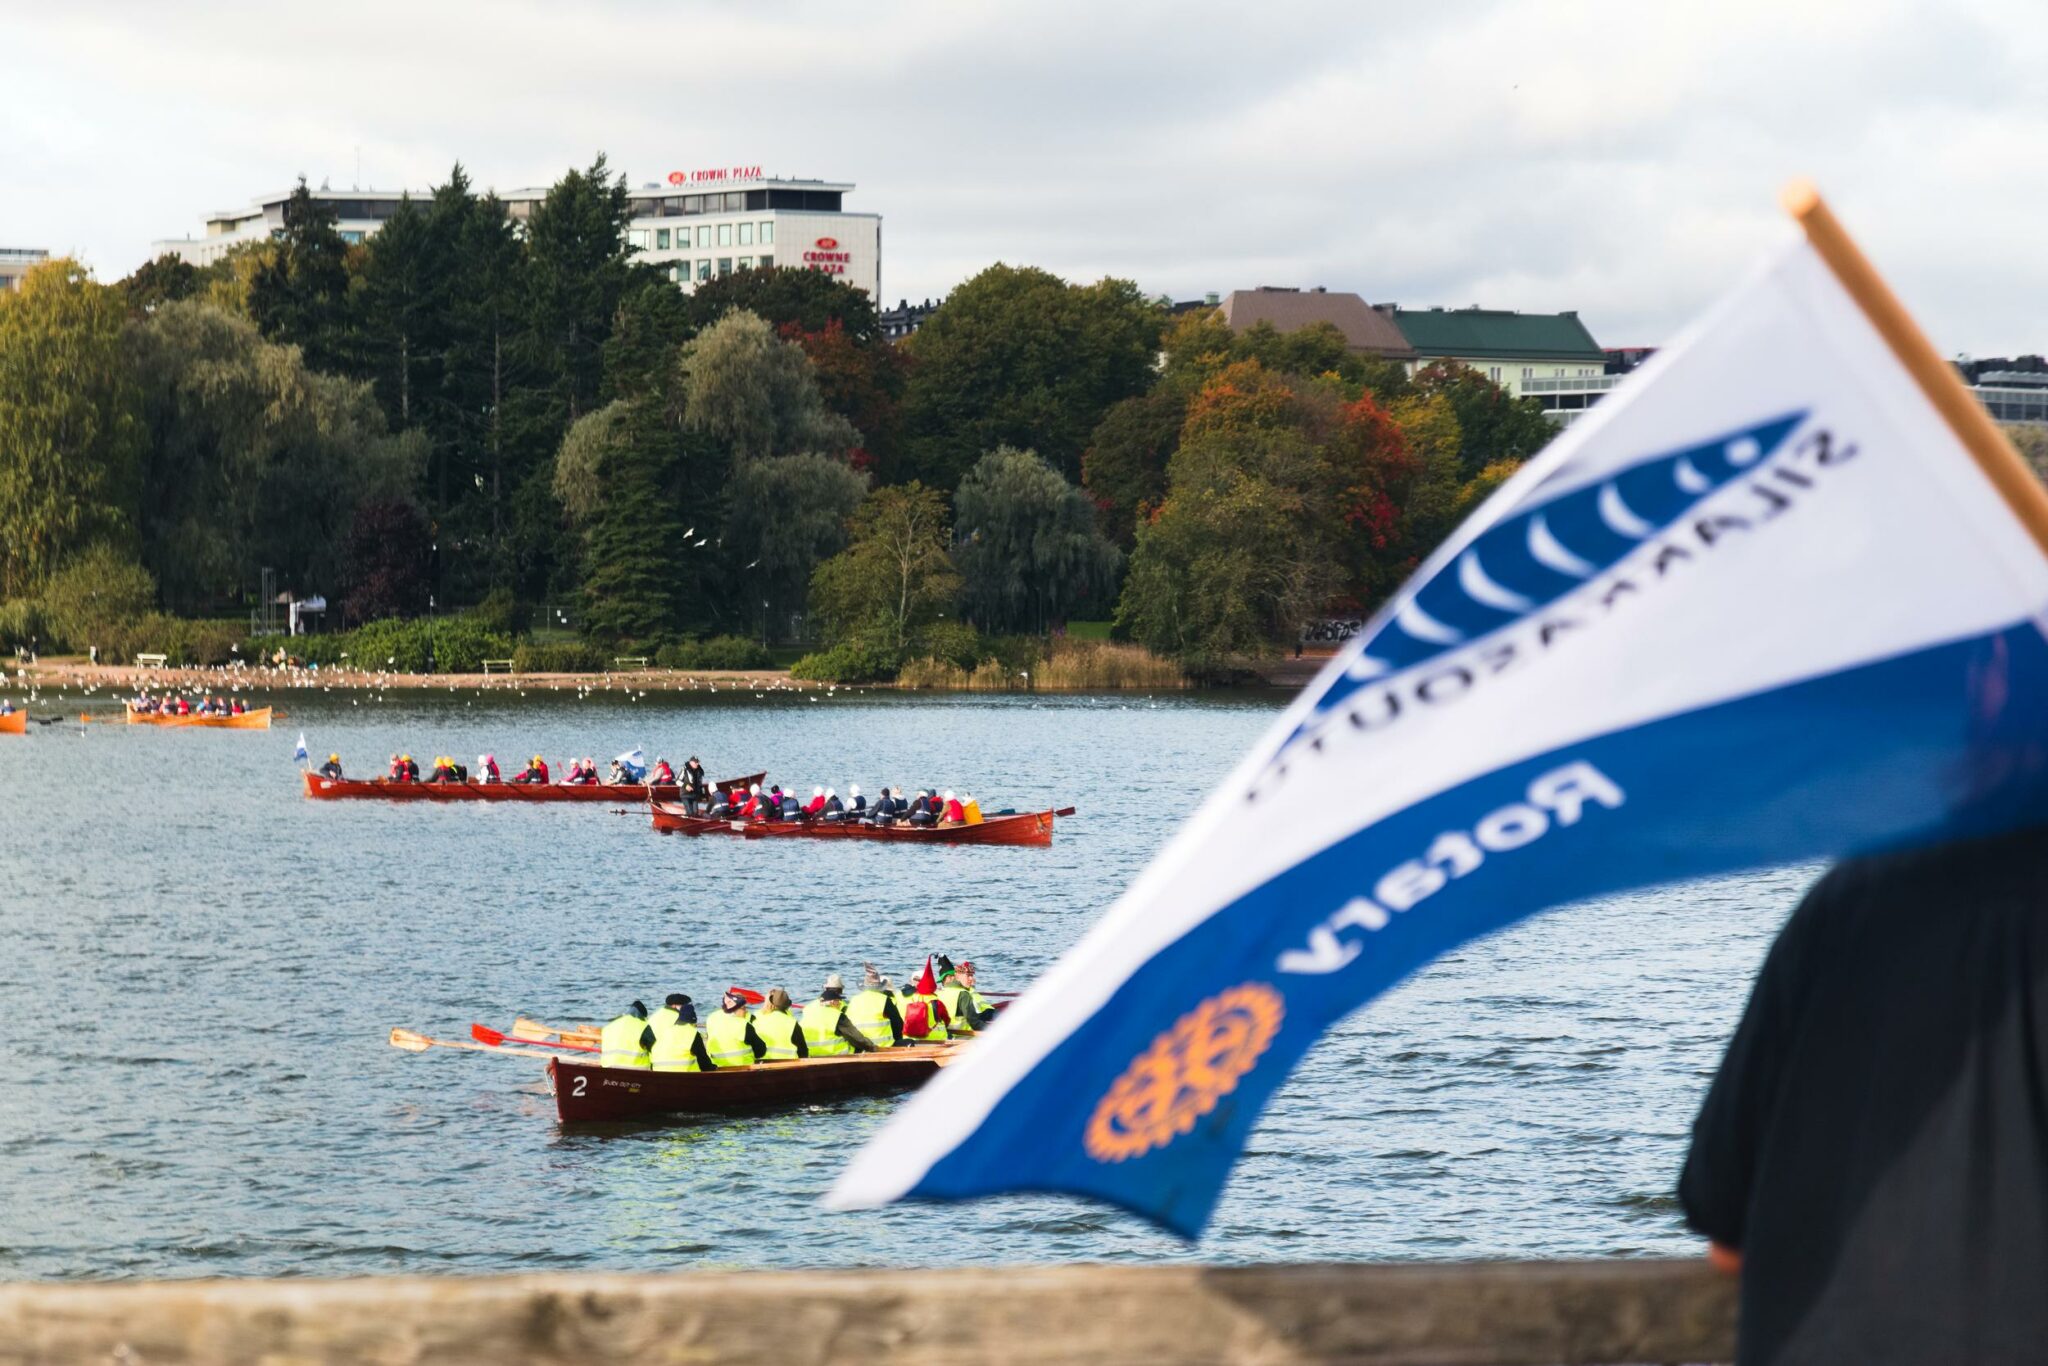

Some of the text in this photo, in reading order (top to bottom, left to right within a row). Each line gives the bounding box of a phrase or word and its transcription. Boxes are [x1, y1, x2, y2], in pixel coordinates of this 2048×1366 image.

[691, 166, 762, 181] CROWNE PLAZA
[803, 251, 850, 263] CROWNE
[809, 263, 844, 274] PAZA
[572, 1076, 588, 1097] 2
